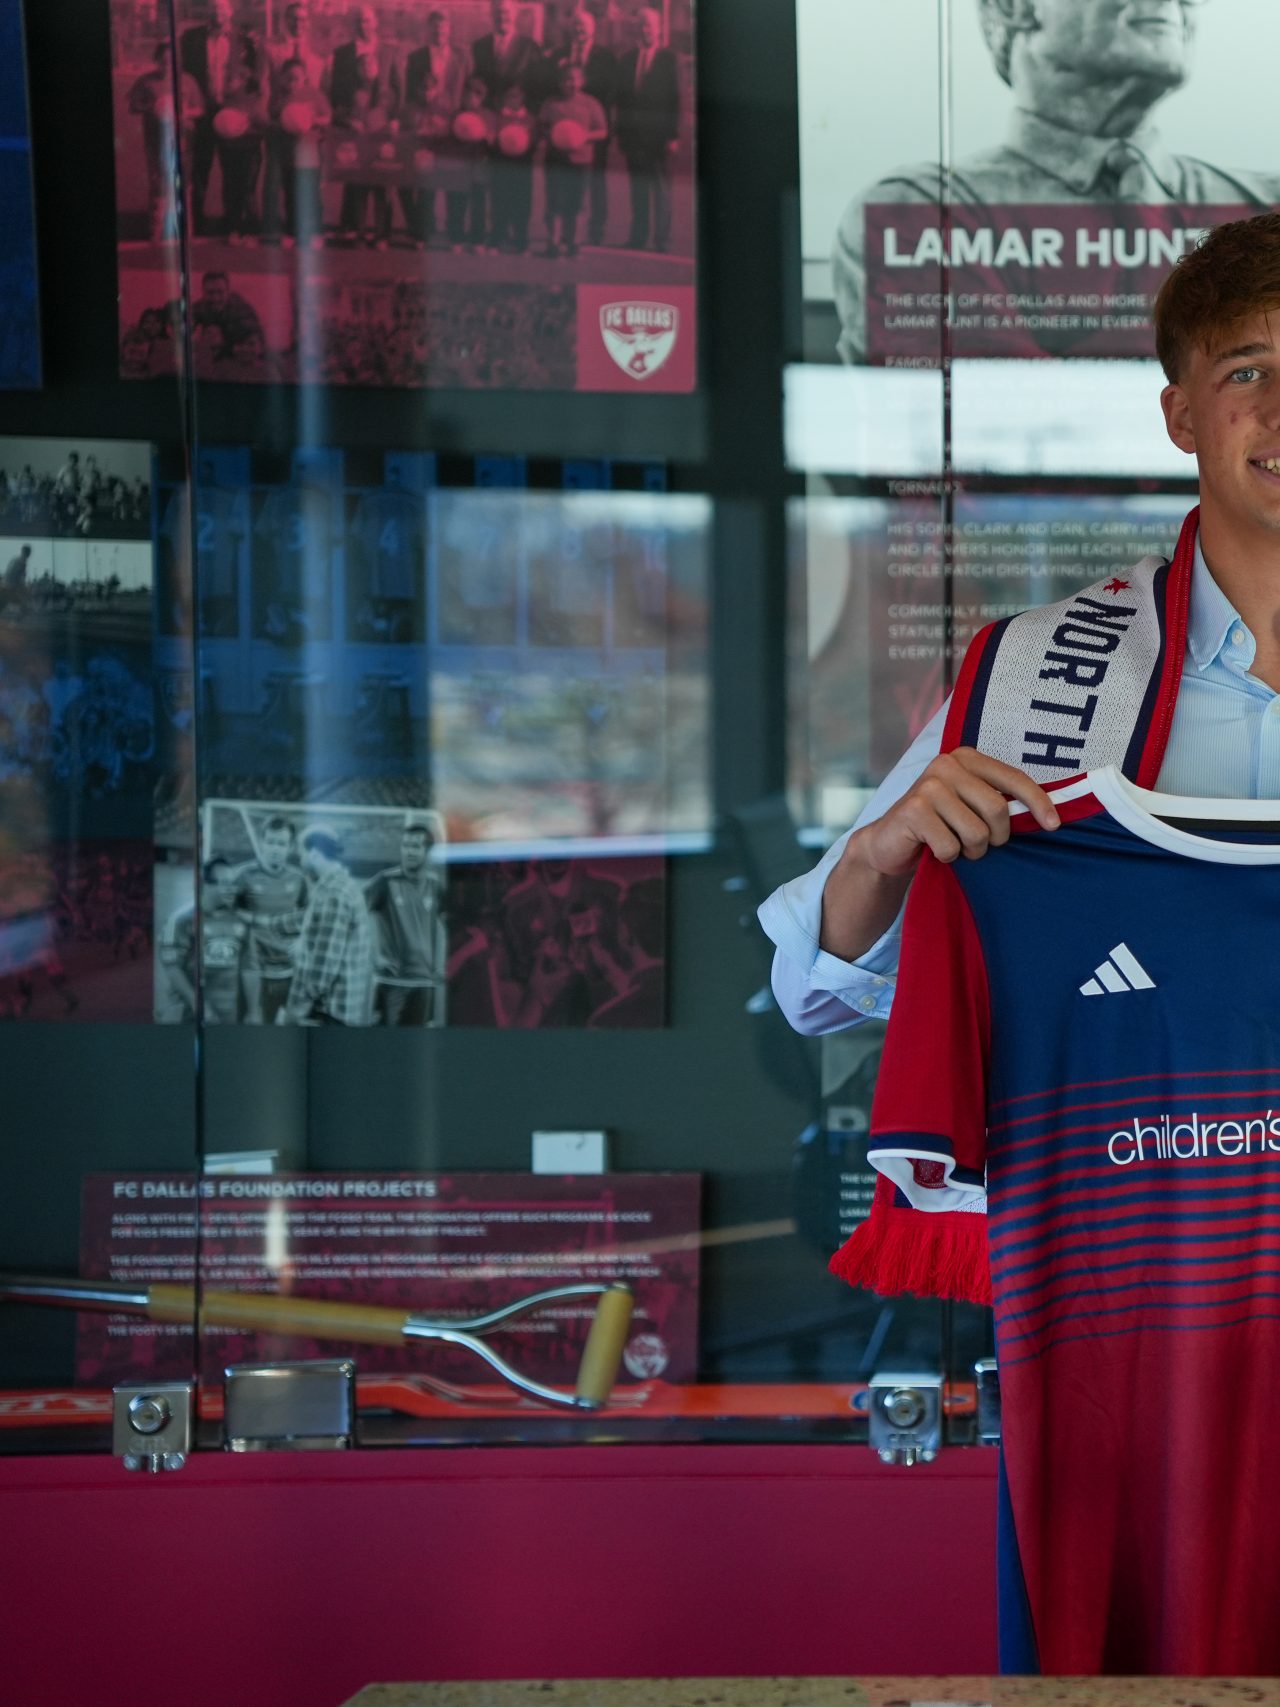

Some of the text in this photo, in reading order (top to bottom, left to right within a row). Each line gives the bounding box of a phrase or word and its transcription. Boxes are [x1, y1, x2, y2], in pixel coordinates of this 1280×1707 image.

[884, 228, 1063, 267] LAMAR
[1006, 294, 1065, 307] DALLAS
[1067, 294, 1100, 307] AND
[1103, 294, 1148, 307] MORE
[884, 315, 937, 328] LAMAR
[1015, 315, 1081, 328] PIONEER
[1102, 315, 1149, 328] EVERY
[963, 522, 1011, 536] CLARK
[1022, 597, 1138, 769] NORTH
[113, 1181, 138, 1198] FC
[219, 1180, 339, 1197] FOUNDATION
[343, 1180, 437, 1197] PROJECTS
